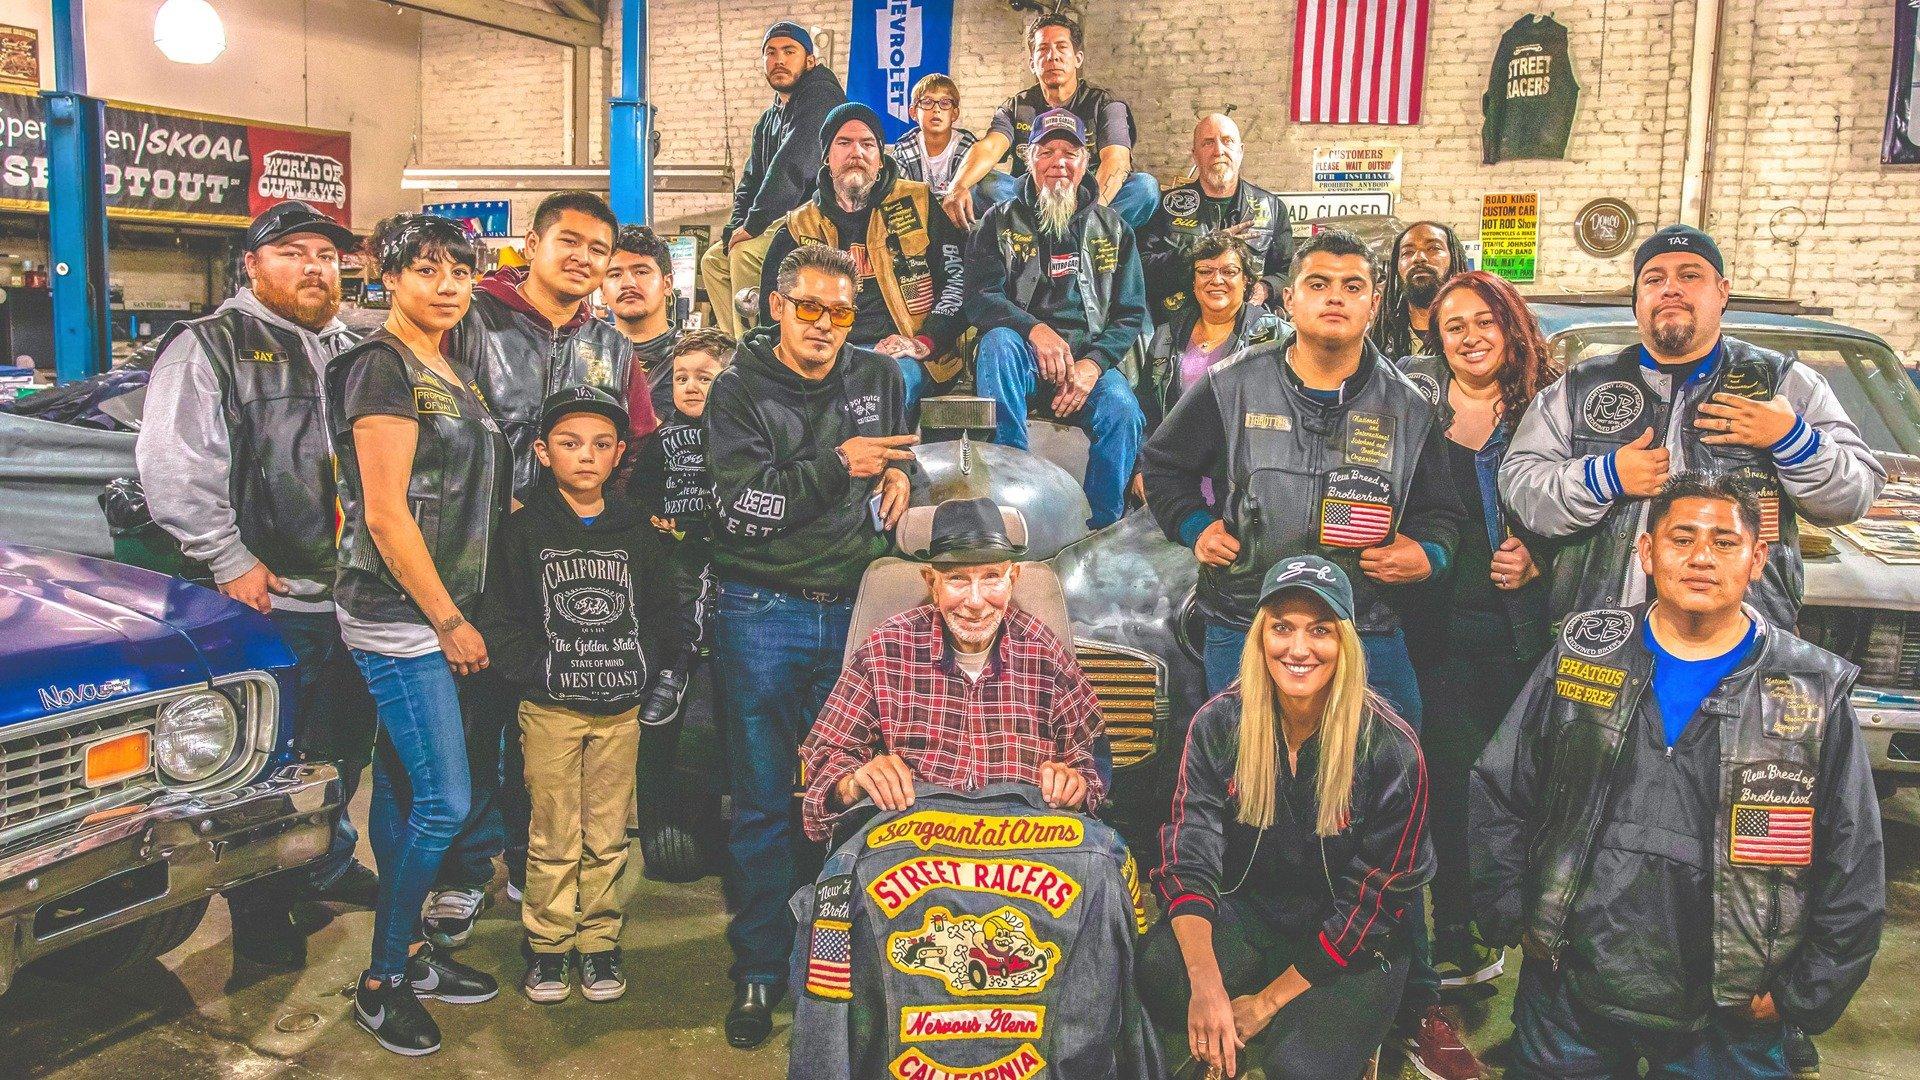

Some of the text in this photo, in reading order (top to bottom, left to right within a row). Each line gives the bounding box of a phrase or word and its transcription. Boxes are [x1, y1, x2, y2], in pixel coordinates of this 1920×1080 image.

[890, 0, 907, 106] EVROLET
[1508, 55, 1552, 79] STREET
[1329, 149, 1383, 160] CUSTOMERS
[263, 157, 342, 182] WORLD OF
[1315, 162, 1340, 171] PLEASE
[1346, 161, 1362, 171] WAIT
[1316, 173, 1335, 181] OUR
[258, 177, 346, 209] OUTLAWS
[1485, 194, 1536, 205] ROAD KINGS
[1316, 204, 1381, 218] CLOSED
[1482, 206, 1517, 217] CUSTOM
[1481, 219, 1497, 230] HOT
[1499, 219, 1516, 230] ROD
[1667, 236, 1689, 246] TAZ
[253, 350, 274, 362] JAY
[424, 401, 437, 410] OF
[1593, 391, 1635, 420] RB
[1328, 469, 1391, 493] New Breed of
[733, 488, 786, 520] 1320
[1326, 485, 1391, 505] Brotherhood
[545, 558, 629, 590] CALIFORNIA
[1575, 616, 1624, 643] RB
[574, 636, 609, 656] Golden
[612, 637, 637, 652] State
[570, 658, 625, 668] STATE OF MIND
[1558, 657, 1626, 688] PHATGUS
[560, 670, 638, 689] WEST COAST
[37, 683, 114, 711] Nova
[1556, 680, 1616, 708] VICE PREZ
[1741, 763, 1816, 791] New Breed of
[1740, 787, 1813, 805] Brotherhood
[874, 818, 986, 846] Sergeant
[982, 819, 1008, 846] at
[817, 883, 842, 902] New
[873, 860, 1073, 910] STREET RACERS
[906, 1008, 1039, 1036] Nervous Glenn
